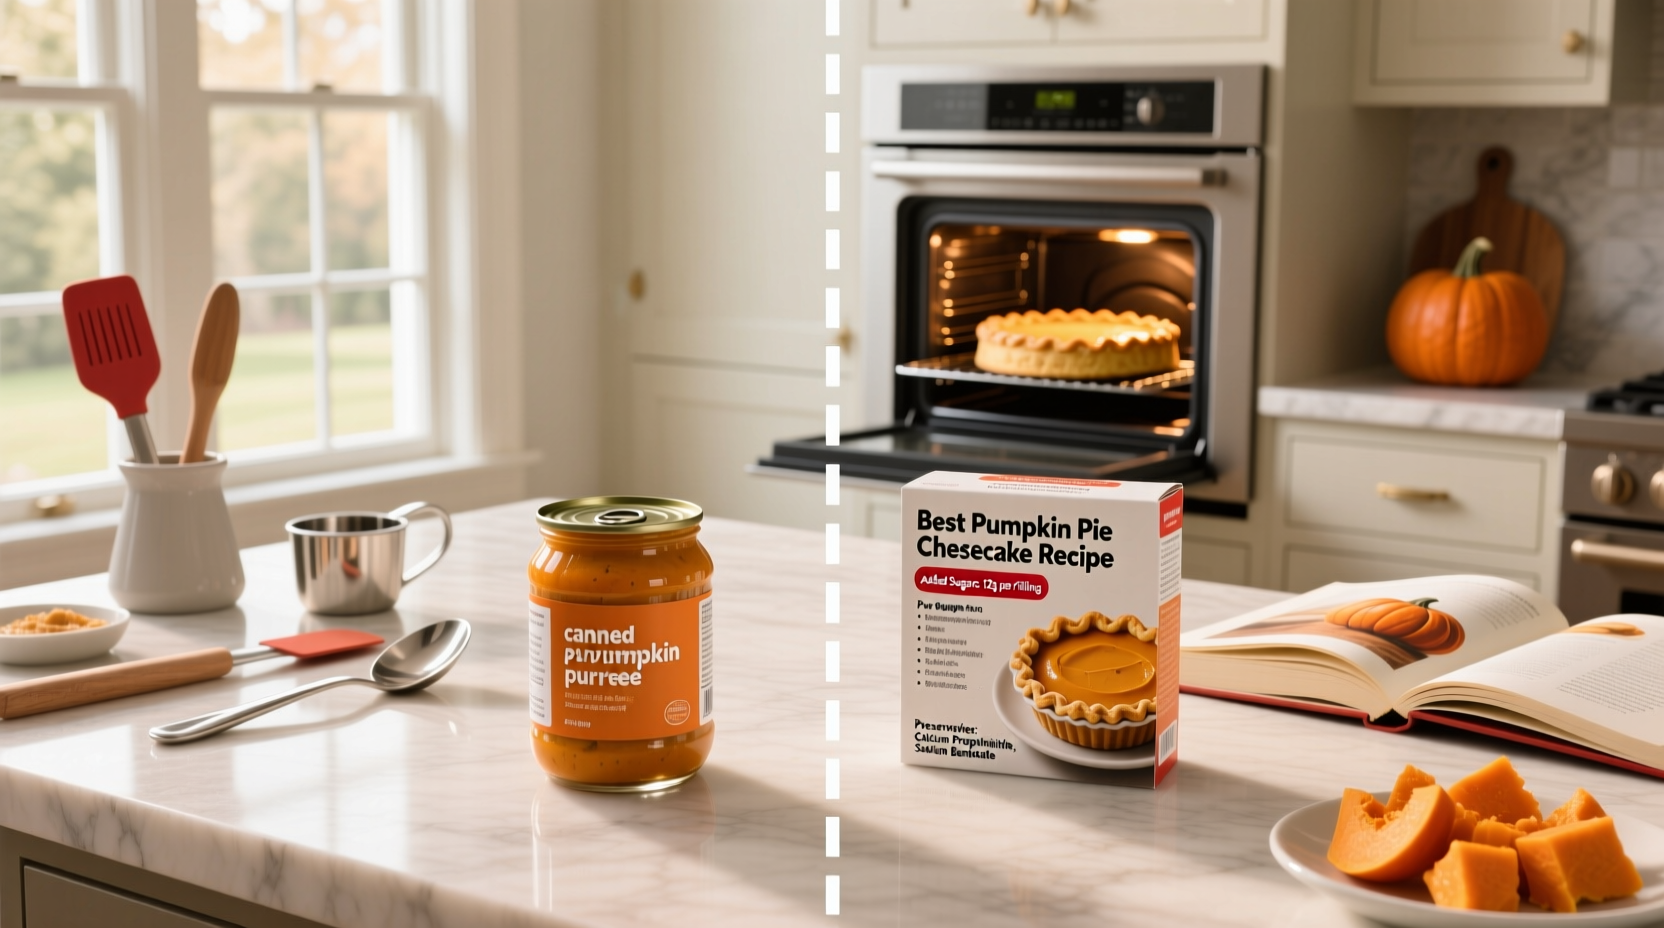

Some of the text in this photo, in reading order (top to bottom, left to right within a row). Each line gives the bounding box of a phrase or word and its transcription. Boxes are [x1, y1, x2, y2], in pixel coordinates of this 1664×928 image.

[917, 509, 1113, 543] Best Pumpkin Pie
[916, 535, 1114, 573] Chesecake Recipe
[564, 625, 635, 645] canned
